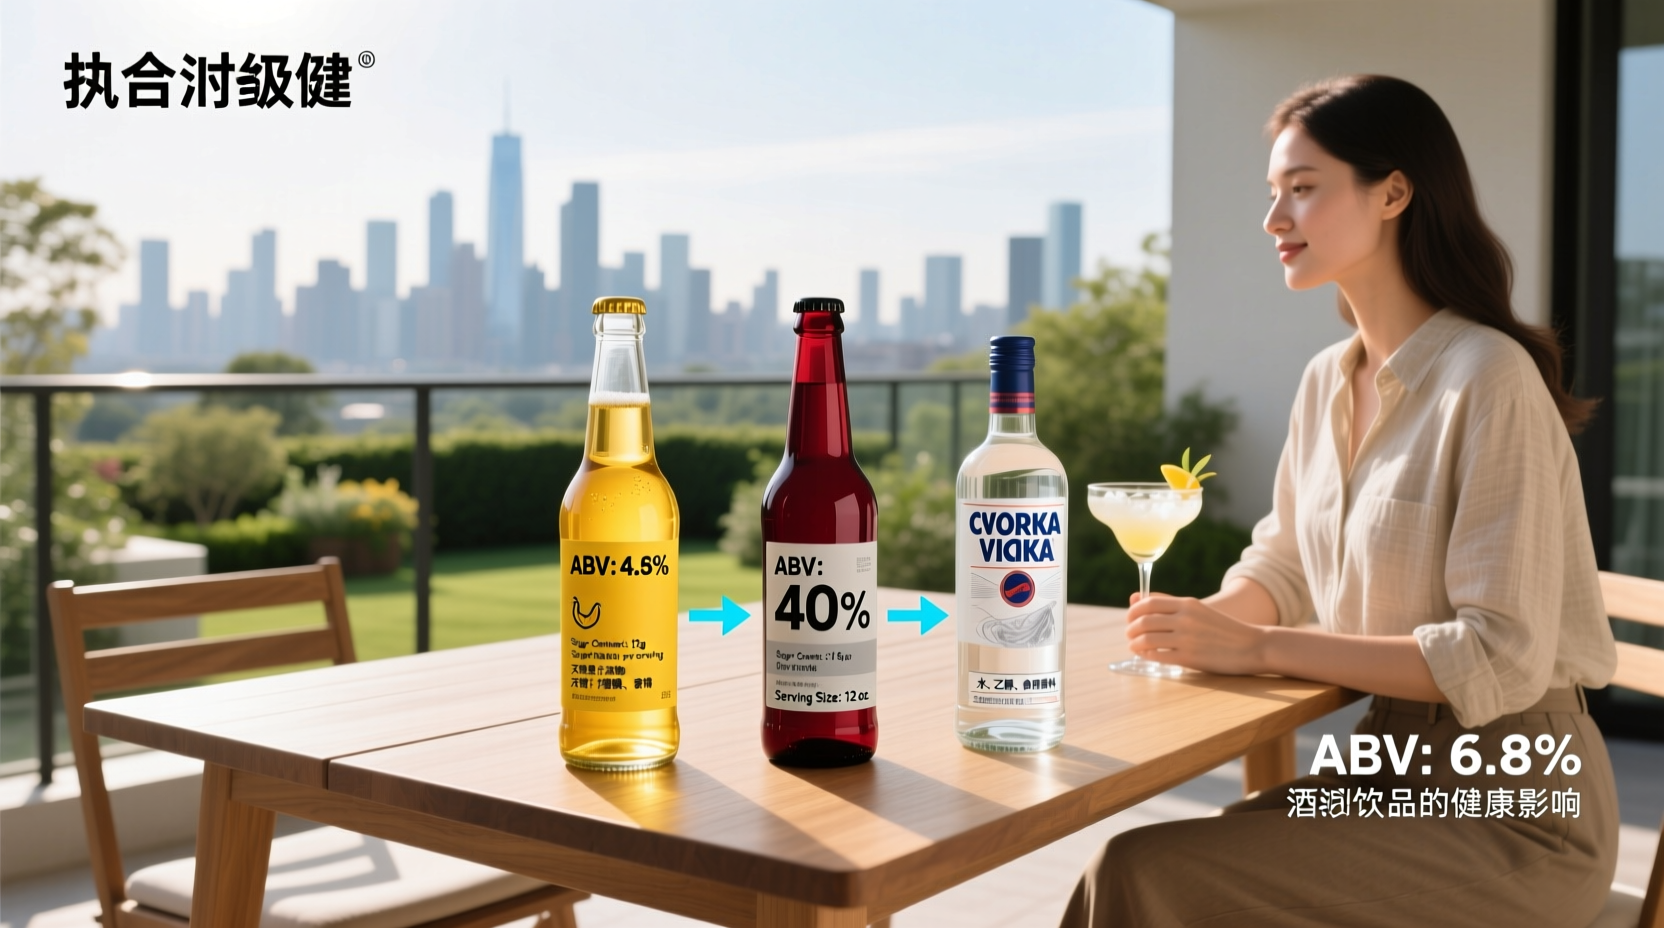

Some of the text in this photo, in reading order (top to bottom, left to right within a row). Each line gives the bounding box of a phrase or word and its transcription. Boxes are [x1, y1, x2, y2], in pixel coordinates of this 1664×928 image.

[969, 511, 1061, 536] CVORKA
[570, 554, 617, 576] ABV:
[774, 555, 823, 576] ABV:
[774, 584, 870, 632] 40%
[774, 689, 813, 707] Serving
[815, 691, 842, 703] Size:
[844, 690, 857, 703] 12
